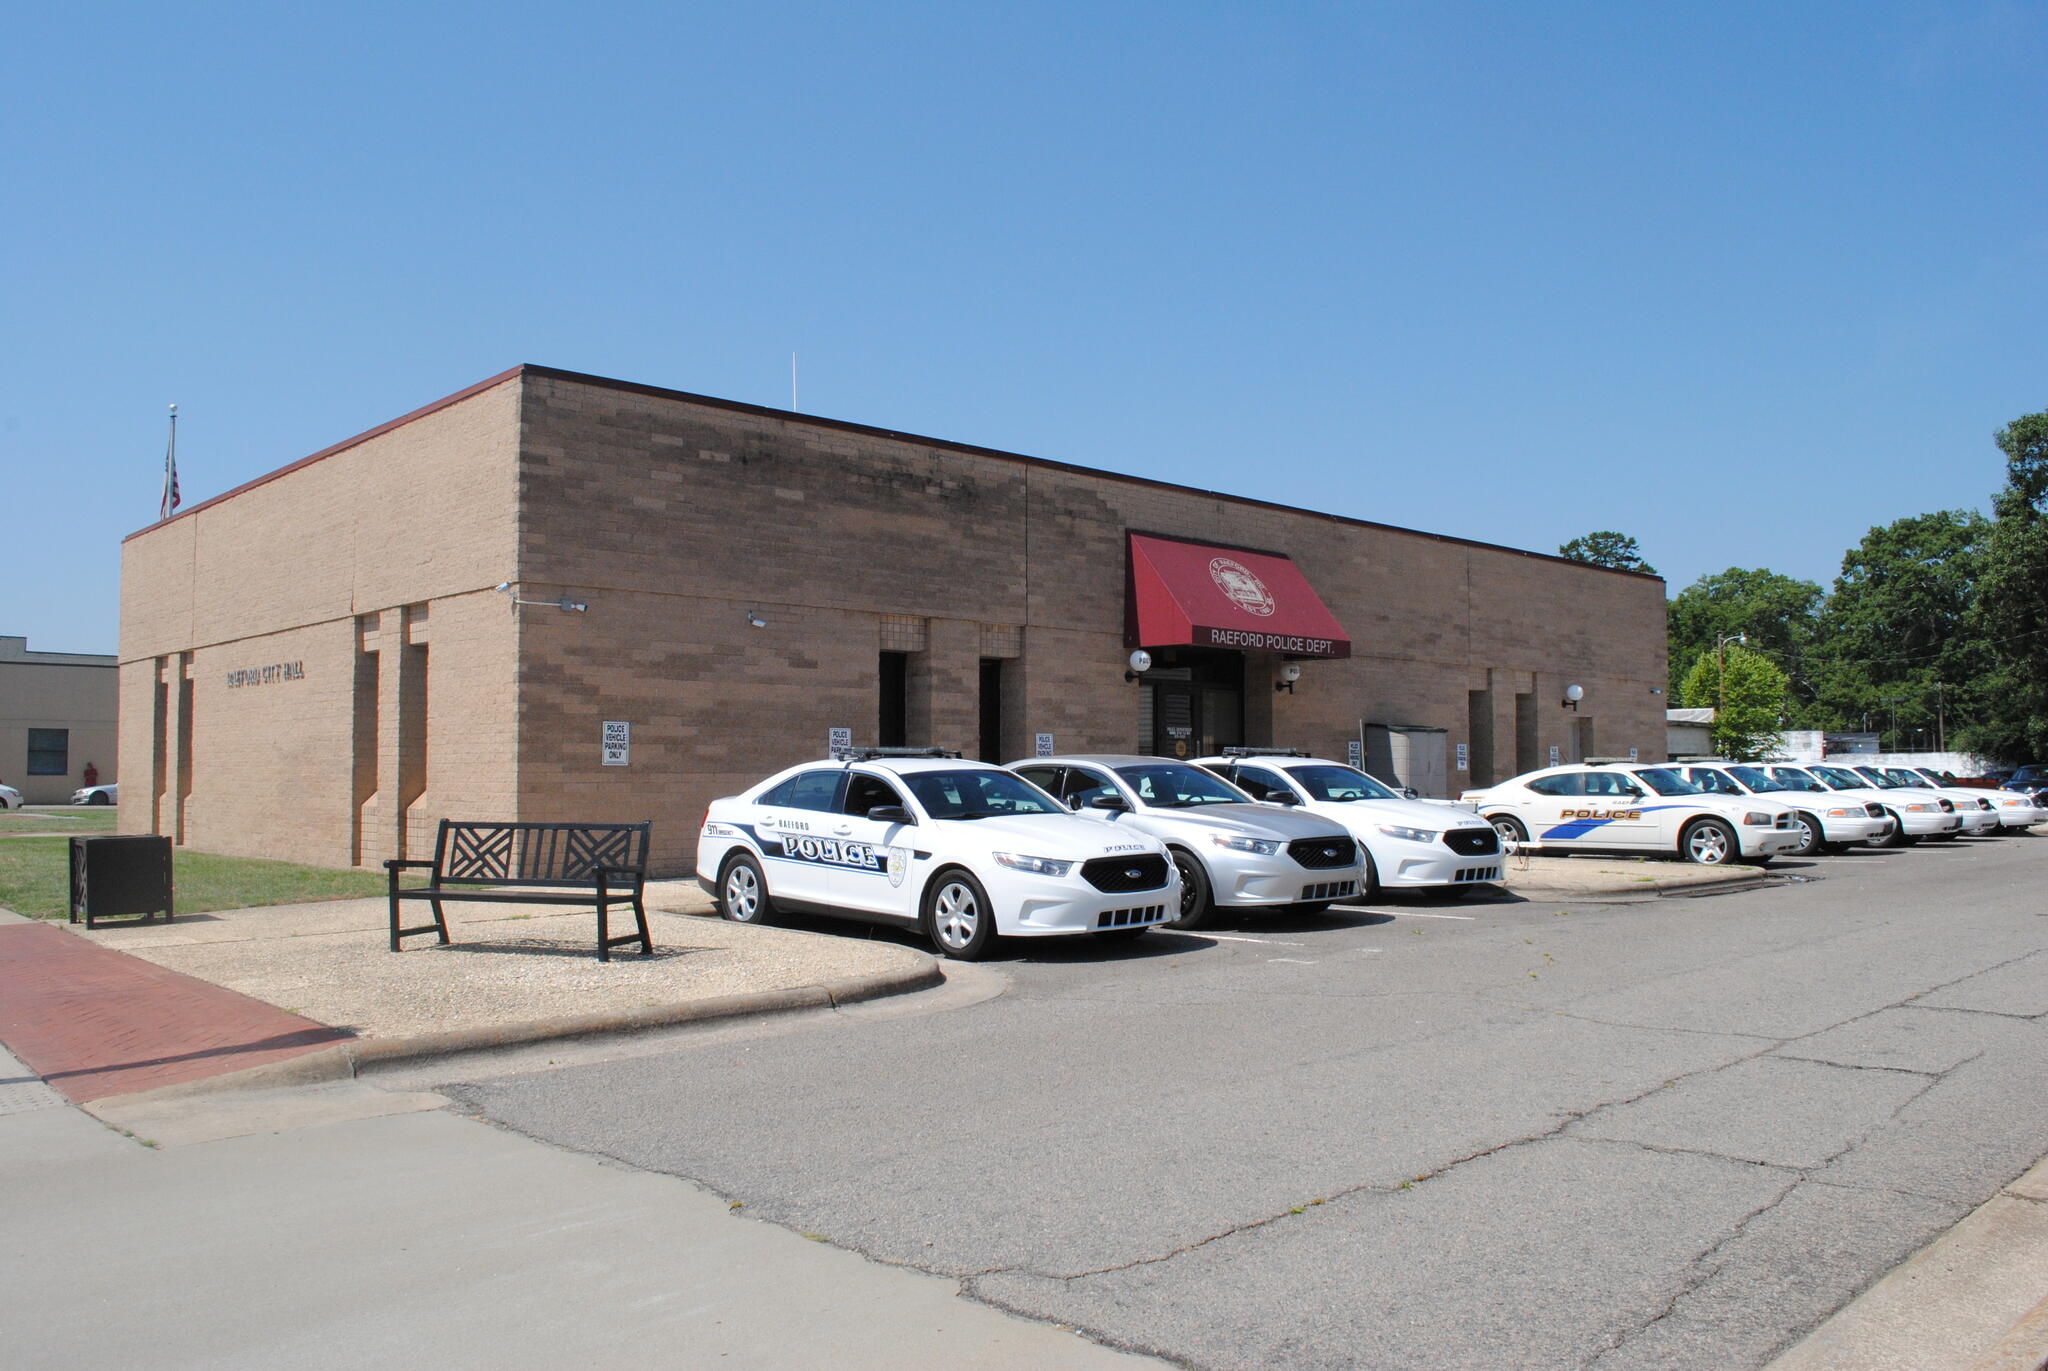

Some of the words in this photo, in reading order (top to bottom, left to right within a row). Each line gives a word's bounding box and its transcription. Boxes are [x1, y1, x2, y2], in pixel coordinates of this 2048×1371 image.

[1211, 629, 1264, 648] RAEFORD
[1266, 634, 1304, 652] POLICE
[1306, 639, 1336, 655] DEPT.
[262, 664, 281, 685] CITY
[284, 660, 305, 681] HALL
[606, 724, 625, 733] POLICE
[606, 733, 626, 741] VEHICLE
[832, 730, 848, 738] POLICE
[604, 742, 626, 750] PARKING
[831, 738, 849, 746] VEHICLE
[608, 750, 622, 759] ONLY
[1560, 809, 1642, 821] POLICE
[707, 824, 718, 836] 911
[780, 832, 880, 869] POLICE
